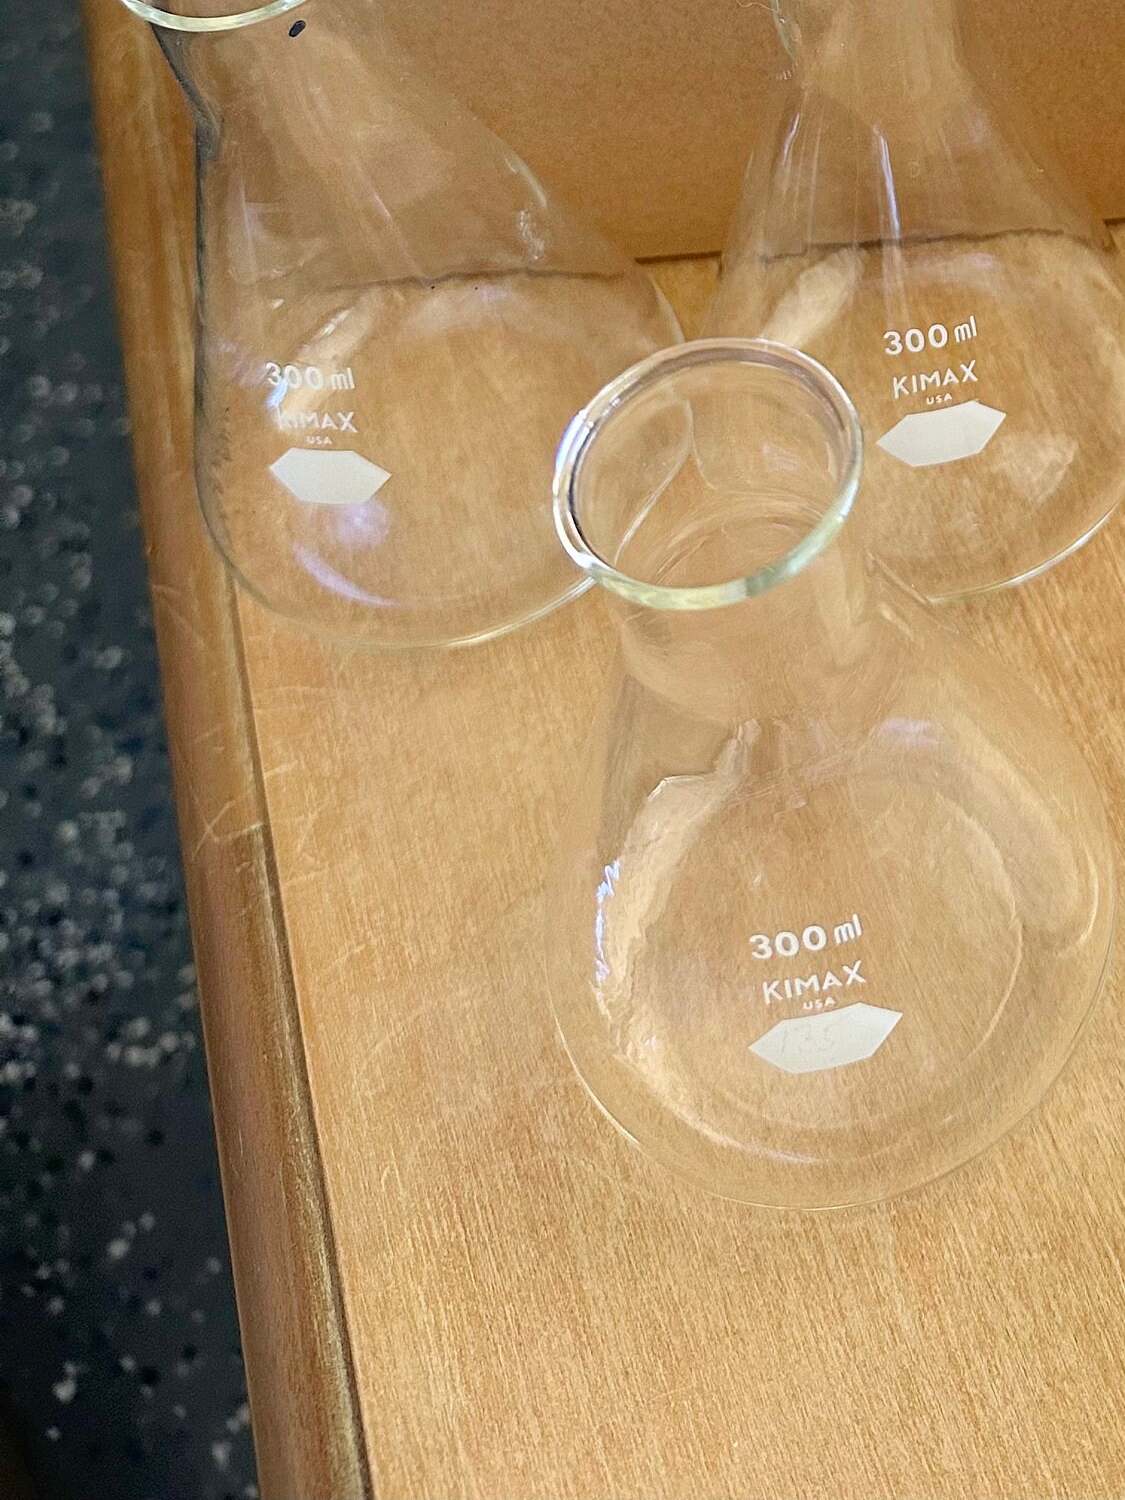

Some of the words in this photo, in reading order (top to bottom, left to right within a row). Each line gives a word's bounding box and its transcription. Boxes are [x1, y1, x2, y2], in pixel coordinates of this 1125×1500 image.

[883, 323, 949, 355] 300
[954, 315, 978, 343] ml
[265, 361, 324, 390] 300
[330, 366, 357, 390] ml
[892, 359, 979, 399] KIMAX
[925, 392, 953, 405] USA
[306, 435, 333, 445] USA
[749, 925, 827, 960] 300
[834, 913, 863, 945] ml
[762, 959, 867, 1005] KIMAX
[802, 996, 836, 1010] USA
